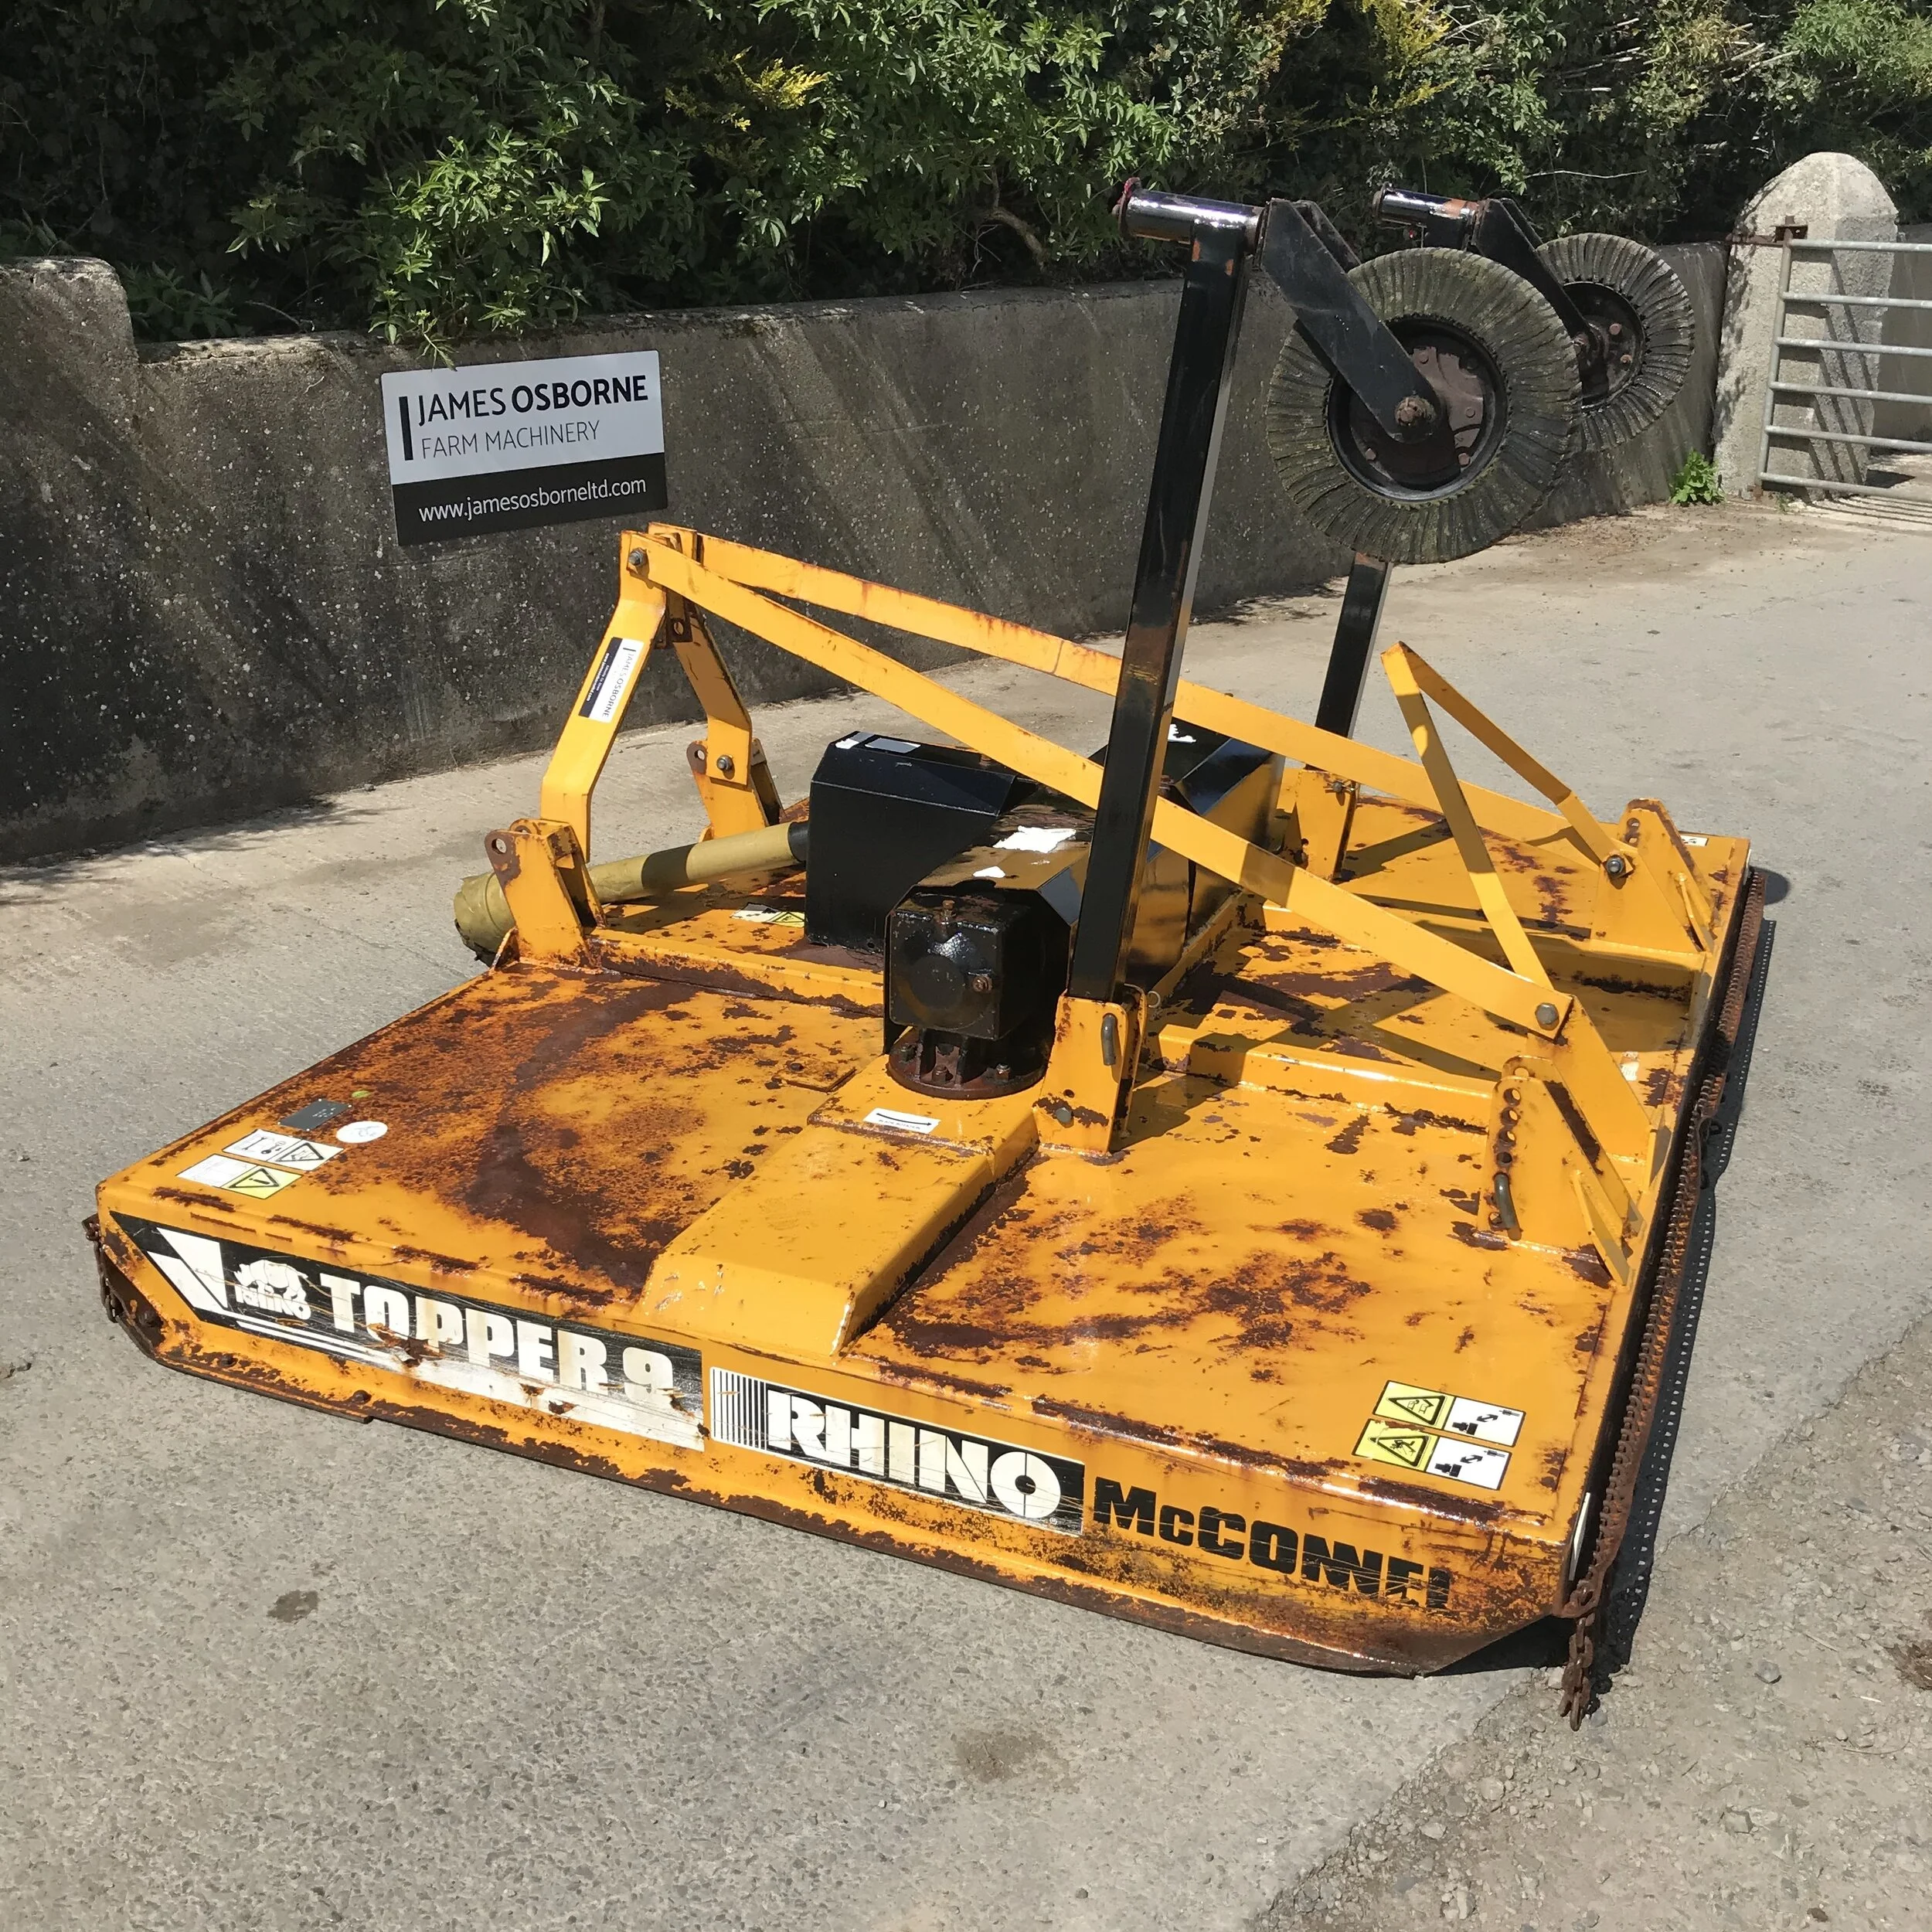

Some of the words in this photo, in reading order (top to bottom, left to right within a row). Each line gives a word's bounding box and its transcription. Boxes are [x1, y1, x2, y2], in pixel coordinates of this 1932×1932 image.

[418, 387, 506, 426] JAMES
[511, 375, 648, 411] OSBORNE
[421, 433, 478, 459] FARM
[485, 420, 600, 451] MACHINERY
[418, 477, 646, 522] www.jamesosborneltd.com
[602, 678, 624, 718] OSBORNE
[319, 1272, 609, 1396] TOPPER
[621, 1346, 674, 1405] 9
[767, 1389, 1062, 1519] RHINO
